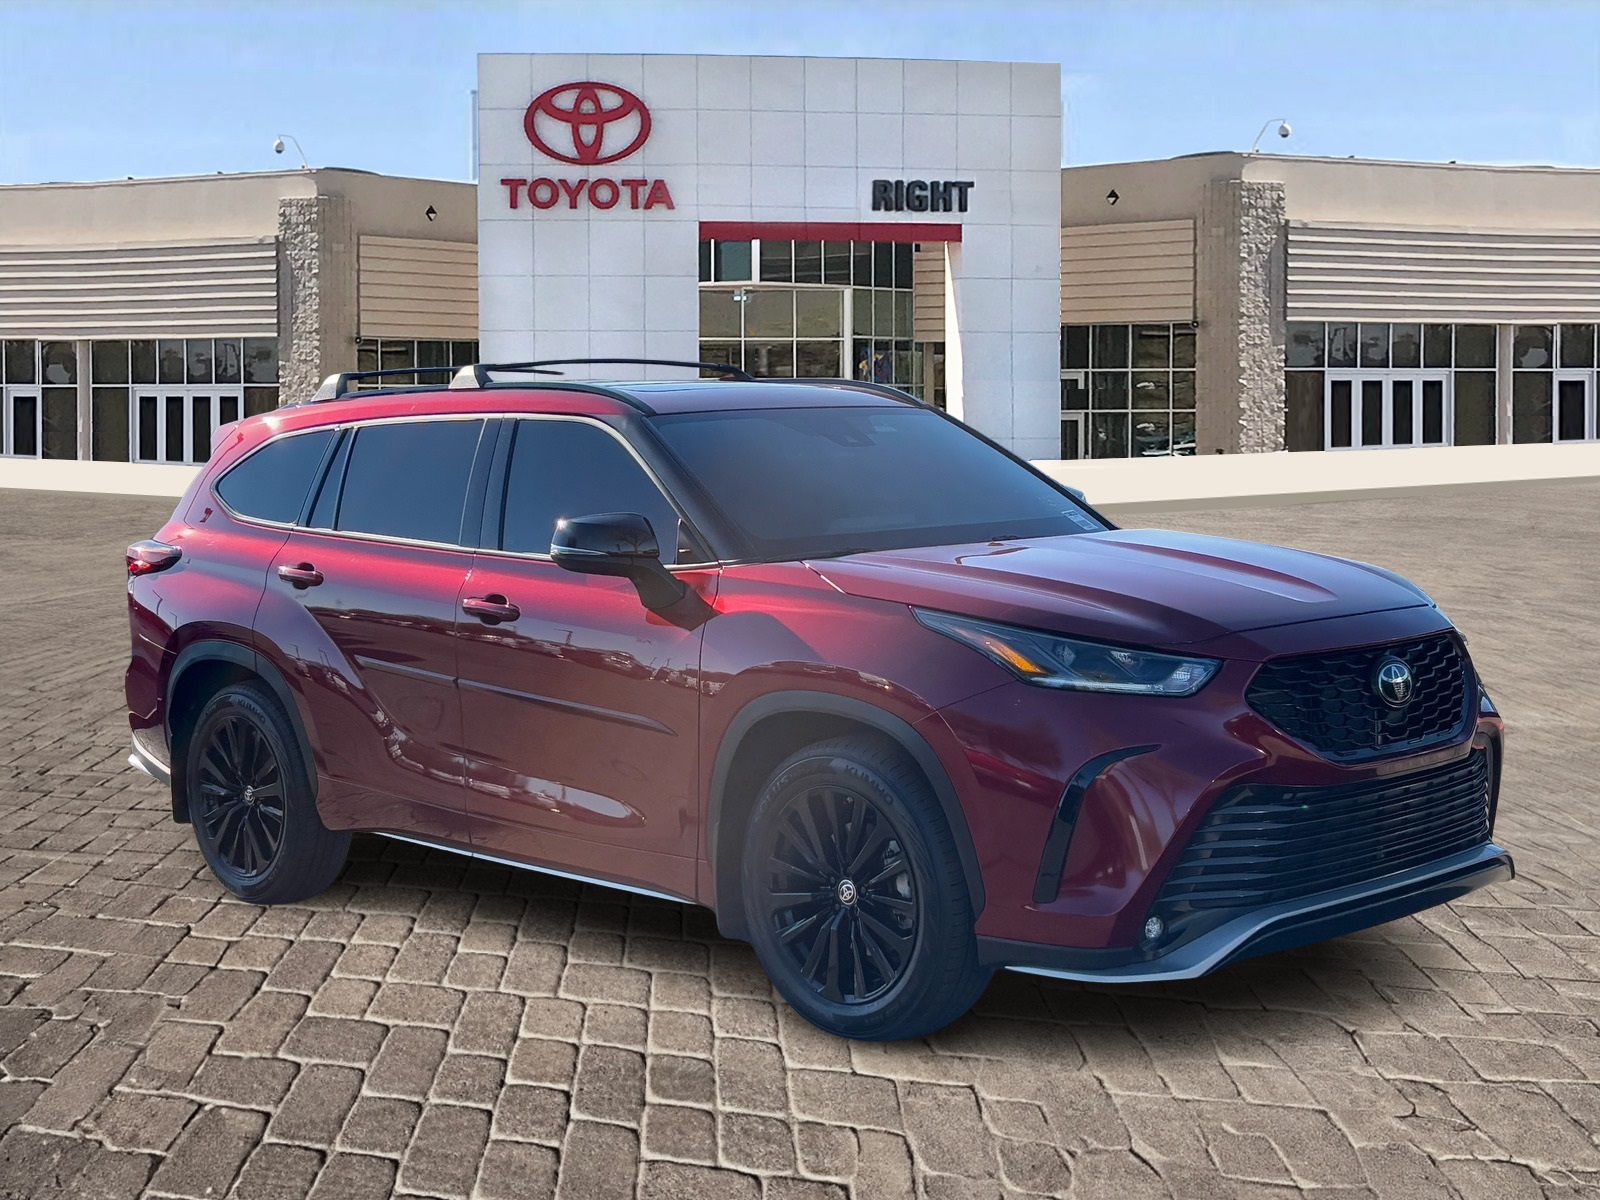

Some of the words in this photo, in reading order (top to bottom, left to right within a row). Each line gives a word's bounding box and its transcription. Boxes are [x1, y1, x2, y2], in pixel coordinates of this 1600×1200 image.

[500, 177, 675, 210] TOYOTA
[872, 179, 975, 212] RIGHT
[237, 699, 266, 724] KUMHO
[844, 765, 894, 805] KUMHO
